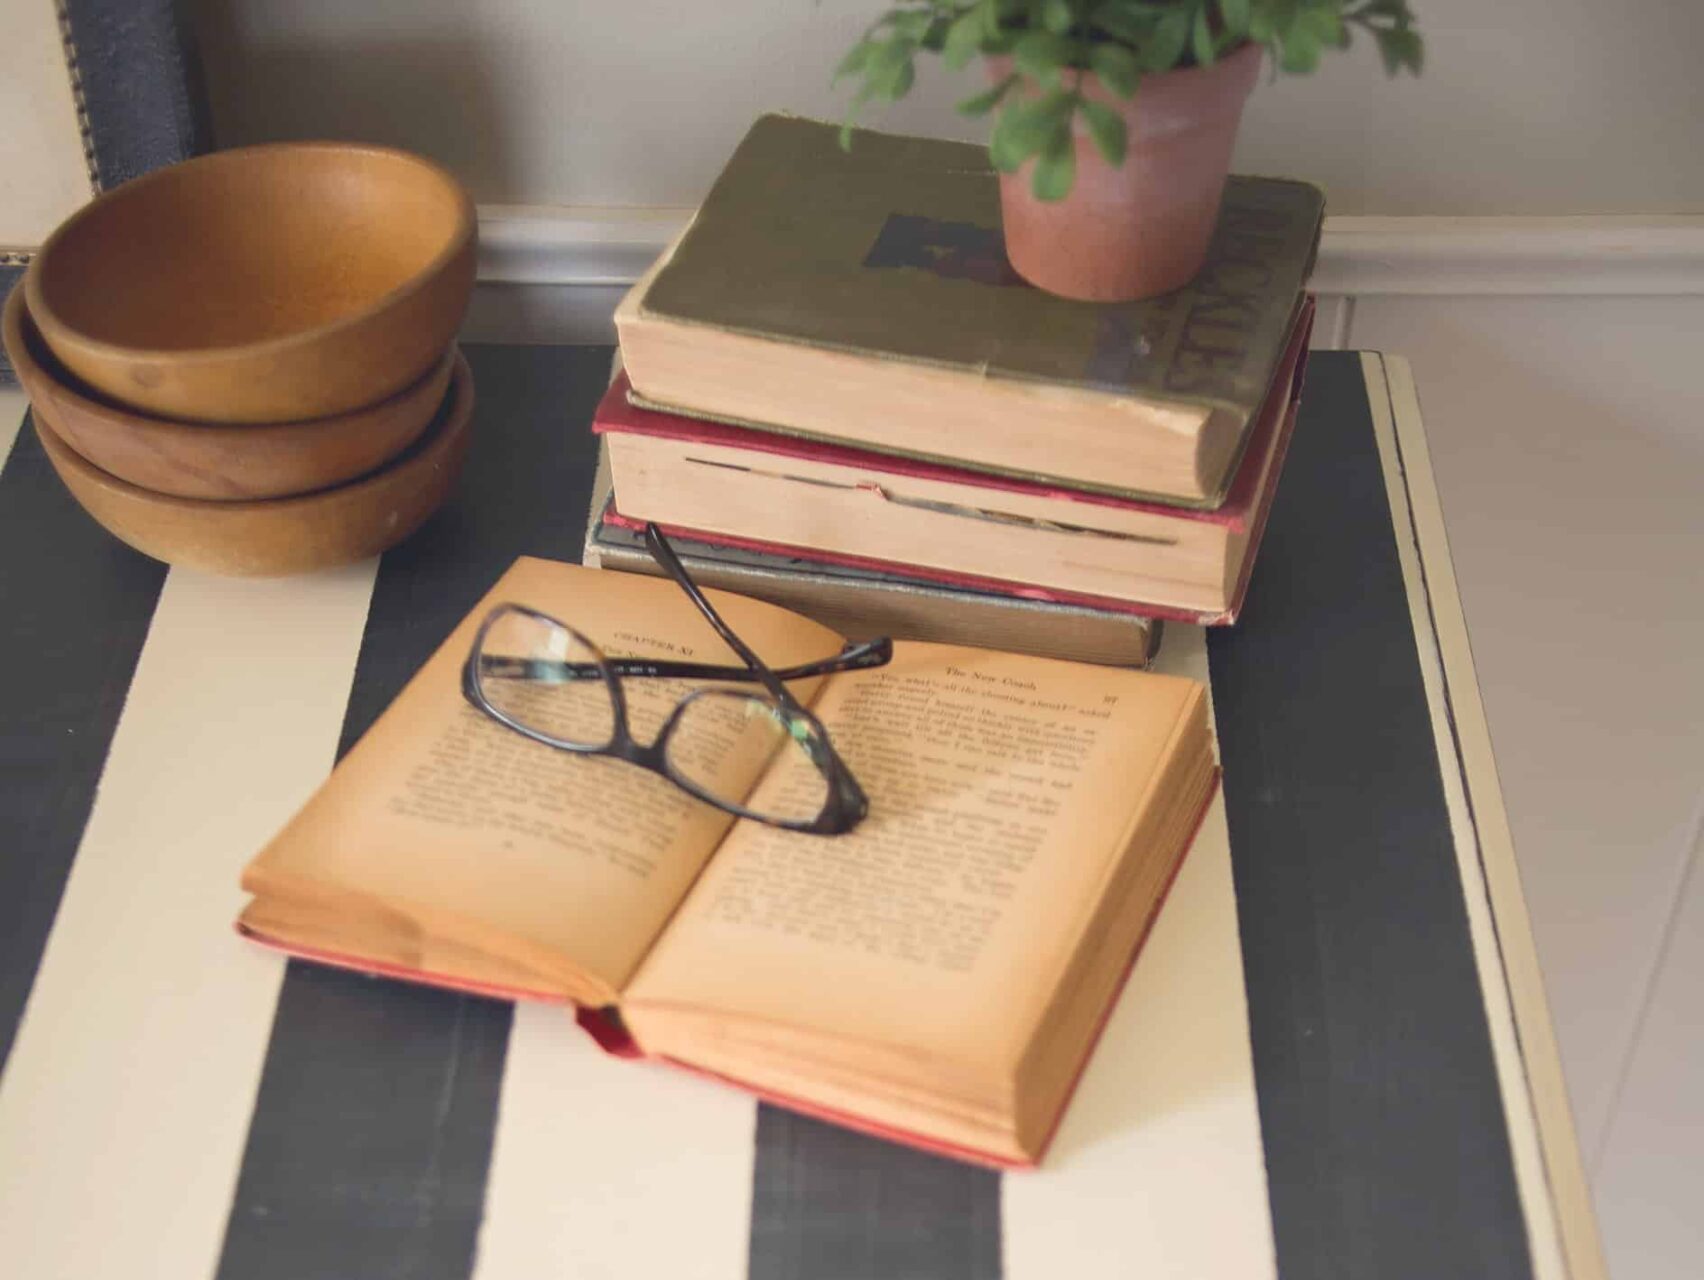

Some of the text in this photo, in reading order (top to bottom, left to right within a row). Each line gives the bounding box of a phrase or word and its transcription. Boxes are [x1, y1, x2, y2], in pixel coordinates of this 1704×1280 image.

[612, 631, 674, 651] CHAPTER
[945, 664, 967, 678] The
[973, 671, 996, 683] New
